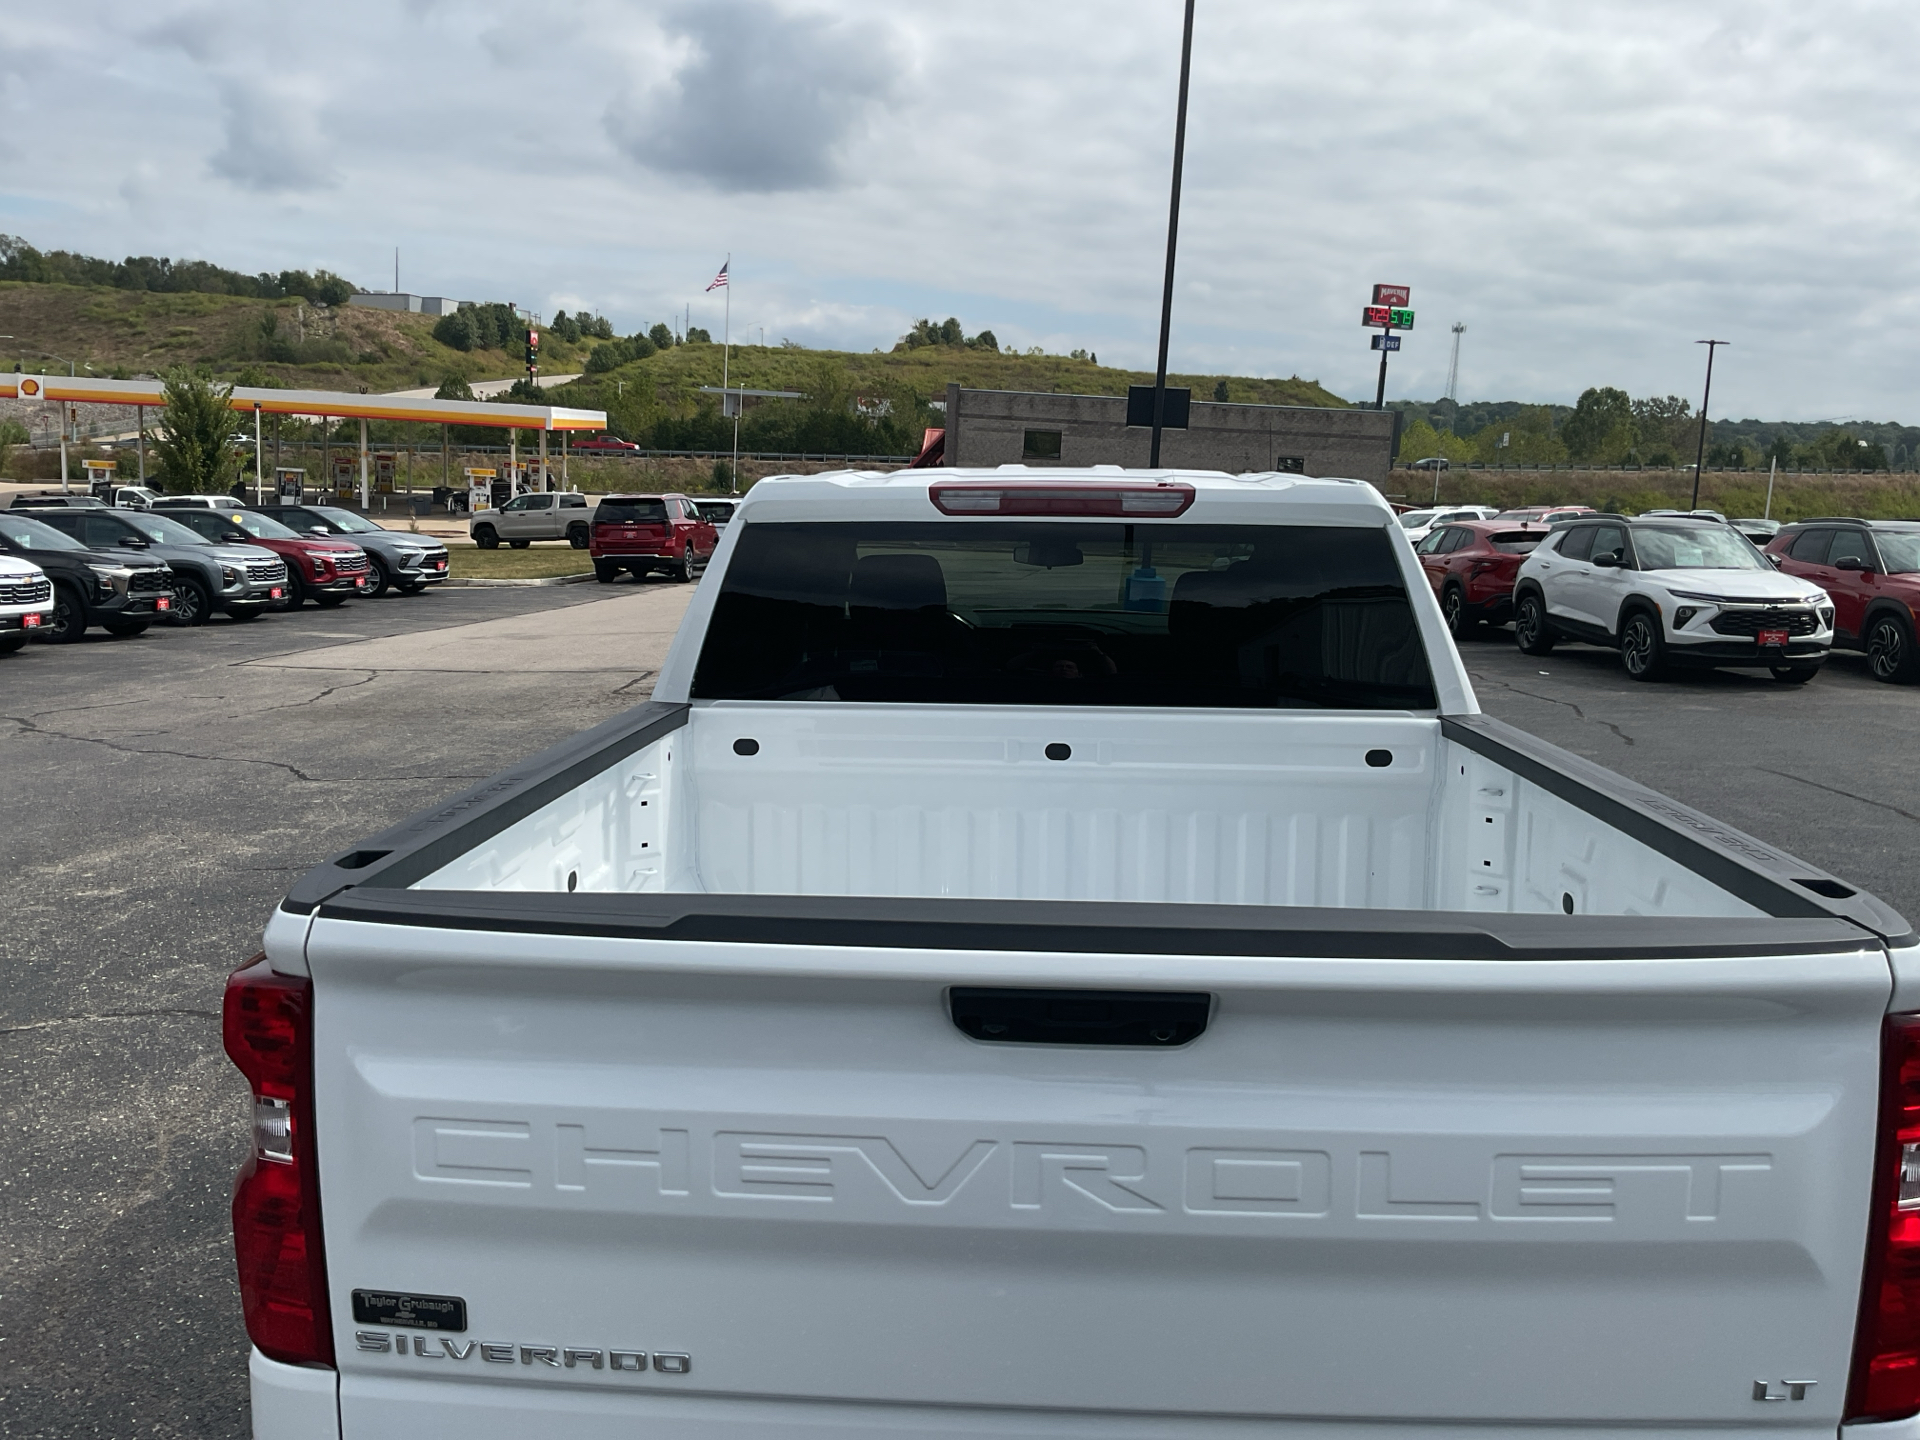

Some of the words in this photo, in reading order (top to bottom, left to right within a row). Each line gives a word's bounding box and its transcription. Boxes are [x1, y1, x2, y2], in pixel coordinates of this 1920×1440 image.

[1380, 287, 1407, 301] MAVERIK
[412, 1115, 1774, 1223] CHEVROLET
[360, 1293, 396, 1308] Taylor
[398, 1296, 454, 1313] Grubaugh
[355, 1330, 692, 1374] SILVERADO
[1752, 1379, 1819, 1402] LT
